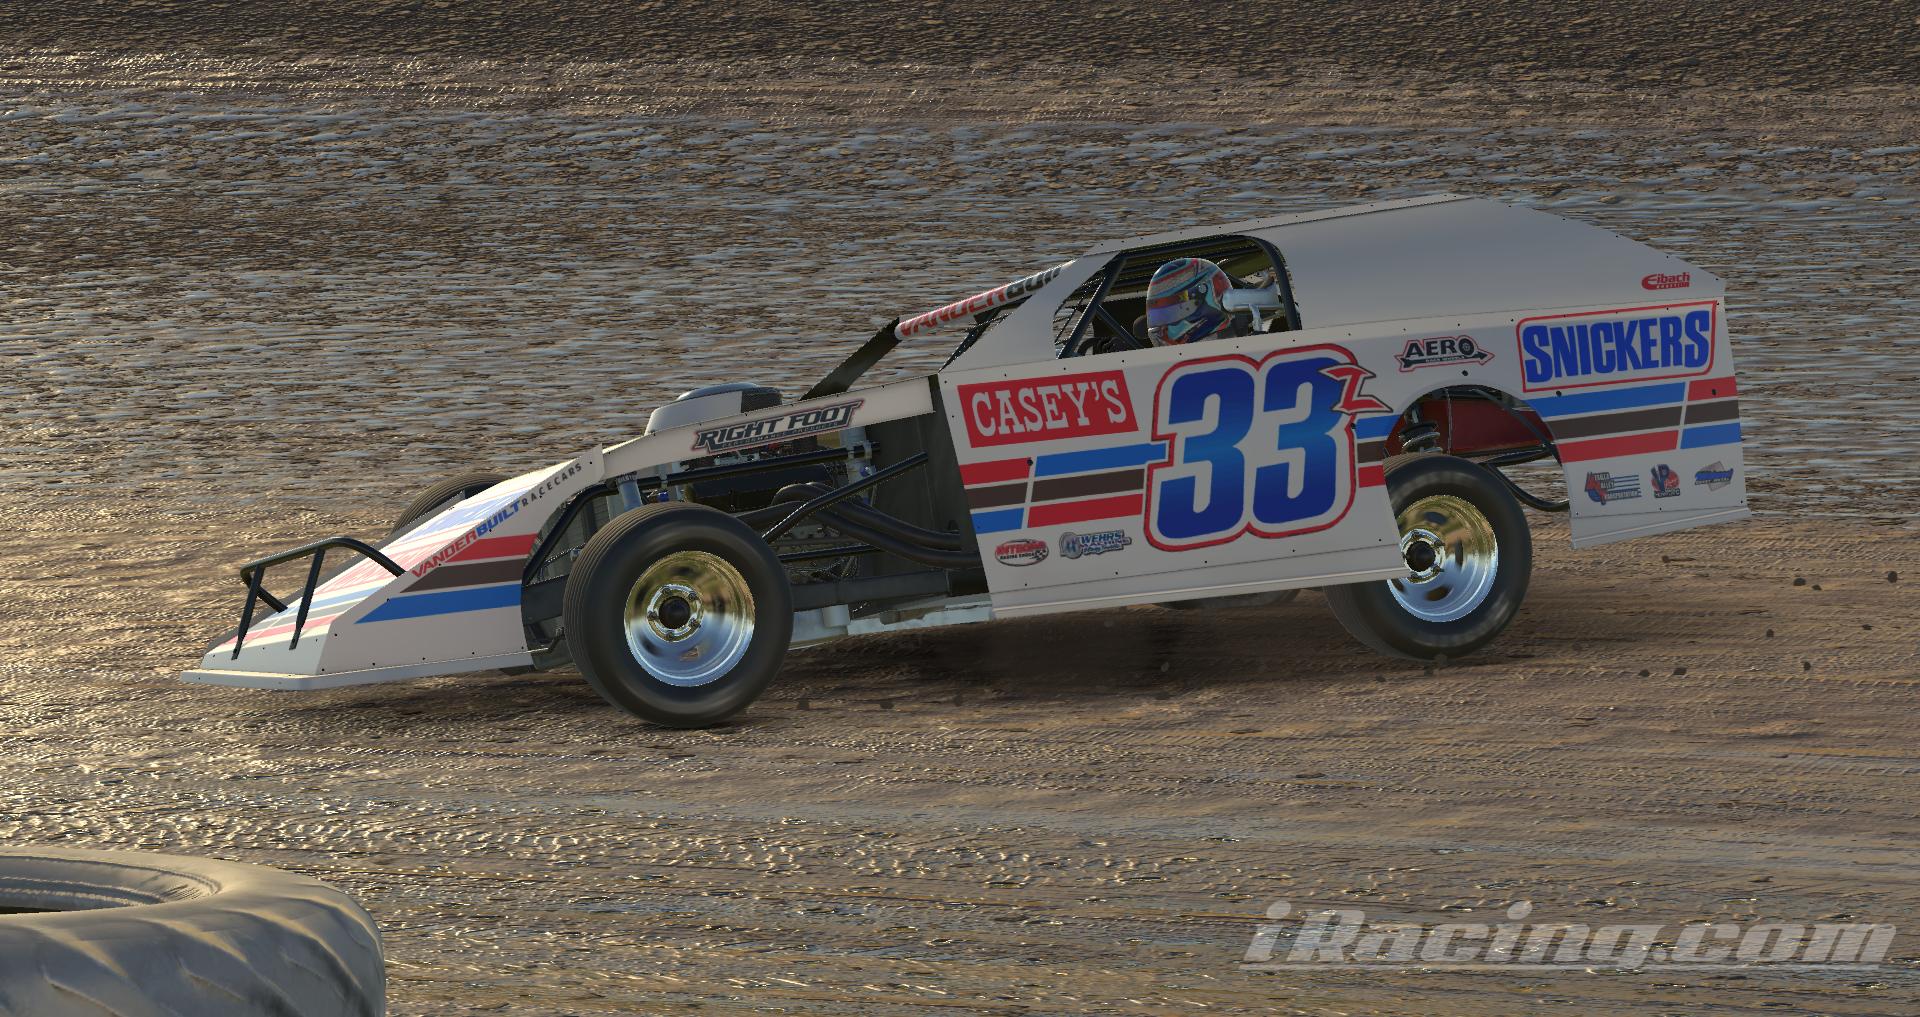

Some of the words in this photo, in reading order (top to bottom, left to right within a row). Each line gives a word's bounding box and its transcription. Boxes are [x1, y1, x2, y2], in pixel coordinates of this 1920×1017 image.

[1641, 272, 1691, 290] Eibach
[1404, 338, 1475, 358] AERO
[1522, 310, 1710, 383] SNICKERS
[696, 417, 784, 450] RIGHT
[787, 402, 863, 430] FOOT
[971, 378, 1128, 438] CASEY'S
[411, 499, 522, 578] VANDERBUILT
[522, 462, 582, 507] RACECARS
[1081, 532, 1122, 544] WEHRS
